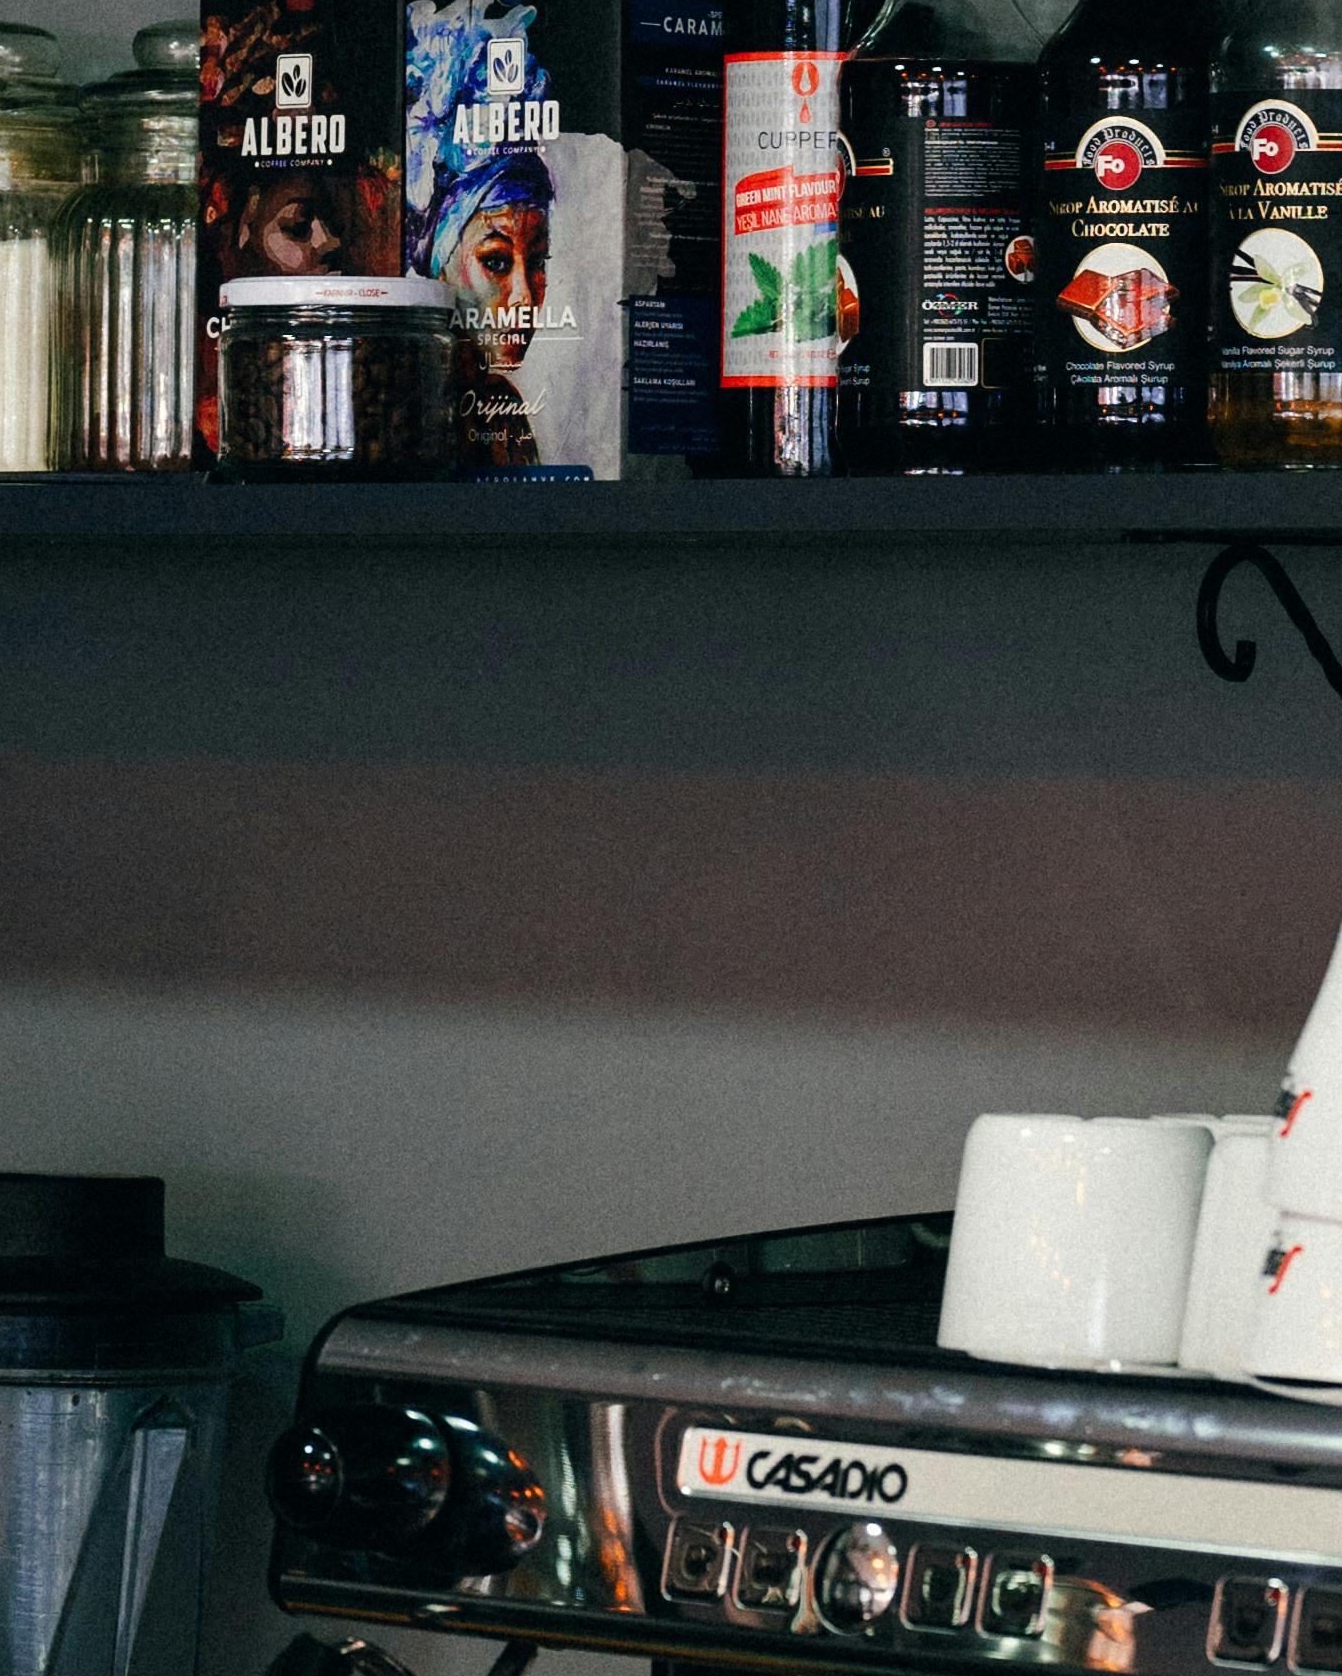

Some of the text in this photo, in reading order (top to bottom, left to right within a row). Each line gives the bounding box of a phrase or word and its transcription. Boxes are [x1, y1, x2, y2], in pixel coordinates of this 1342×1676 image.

[453, 100, 560, 144] ALBERO
[1258, 110, 1310, 150] Products
[241, 114, 346, 157] ALBERO
[472, 146, 539, 156] COFFEE COMPANY
[1101, 127, 1157, 166] Products
[1252, 138, 1279, 161] Fo
[260, 158, 325, 168] COFFEE COMPANY
[1097, 155, 1125, 177] Fo
[762, 185, 788, 203] MINT
[789, 179, 837, 203] FLAVOUR
[1085, 195, 1180, 214] AROMATISÉ
[1257, 201, 1328, 220] VANILLE
[761, 206, 791, 226] NANE
[1071, 218, 1171, 237] CHOCOLATE
[359, 289, 380, 297] CLOSE
[478, 334, 527, 346] SPECIAL
[1278, 345, 1305, 357] Sugar
[1306, 345, 1335, 357] Syrup
[1065, 360, 1176, 371] Chocolate Flavored Syrup
[459, 386, 547, 423] Orijinal
[468, 428, 507, 445] Original
[746, 1449, 909, 1504] CASADIO
